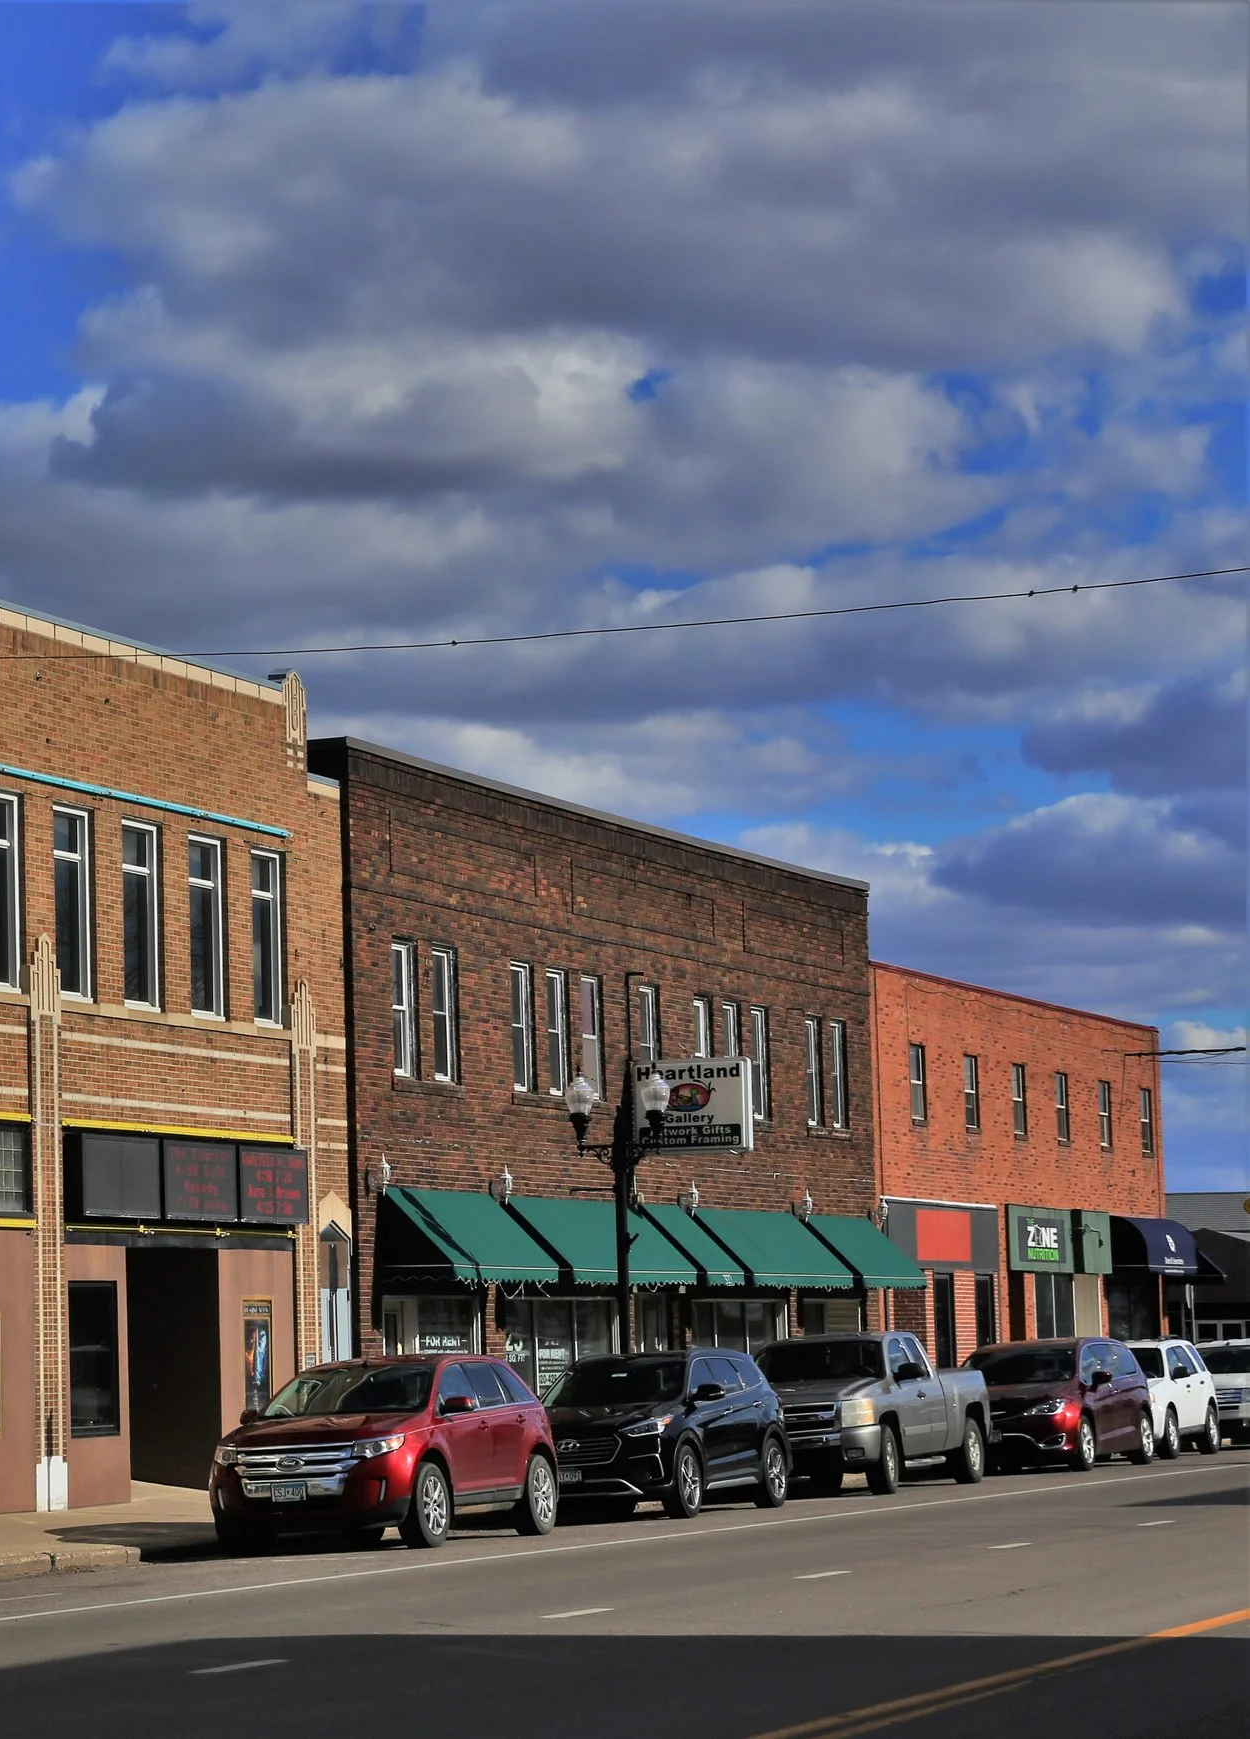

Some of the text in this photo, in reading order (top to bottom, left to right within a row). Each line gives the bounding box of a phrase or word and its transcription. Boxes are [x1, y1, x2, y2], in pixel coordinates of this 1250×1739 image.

[636, 1063, 740, 1082] Heartland
[664, 1113, 715, 1124] Gallery
[650, 1126, 732, 1137] twork Gifts
[690, 1135, 740, 1145] Framing
[1026, 1224, 1058, 1249] ZONE
[1027, 1247, 1059, 1261] NUTRITION
[425, 1336, 461, 1347] FOR RENT
